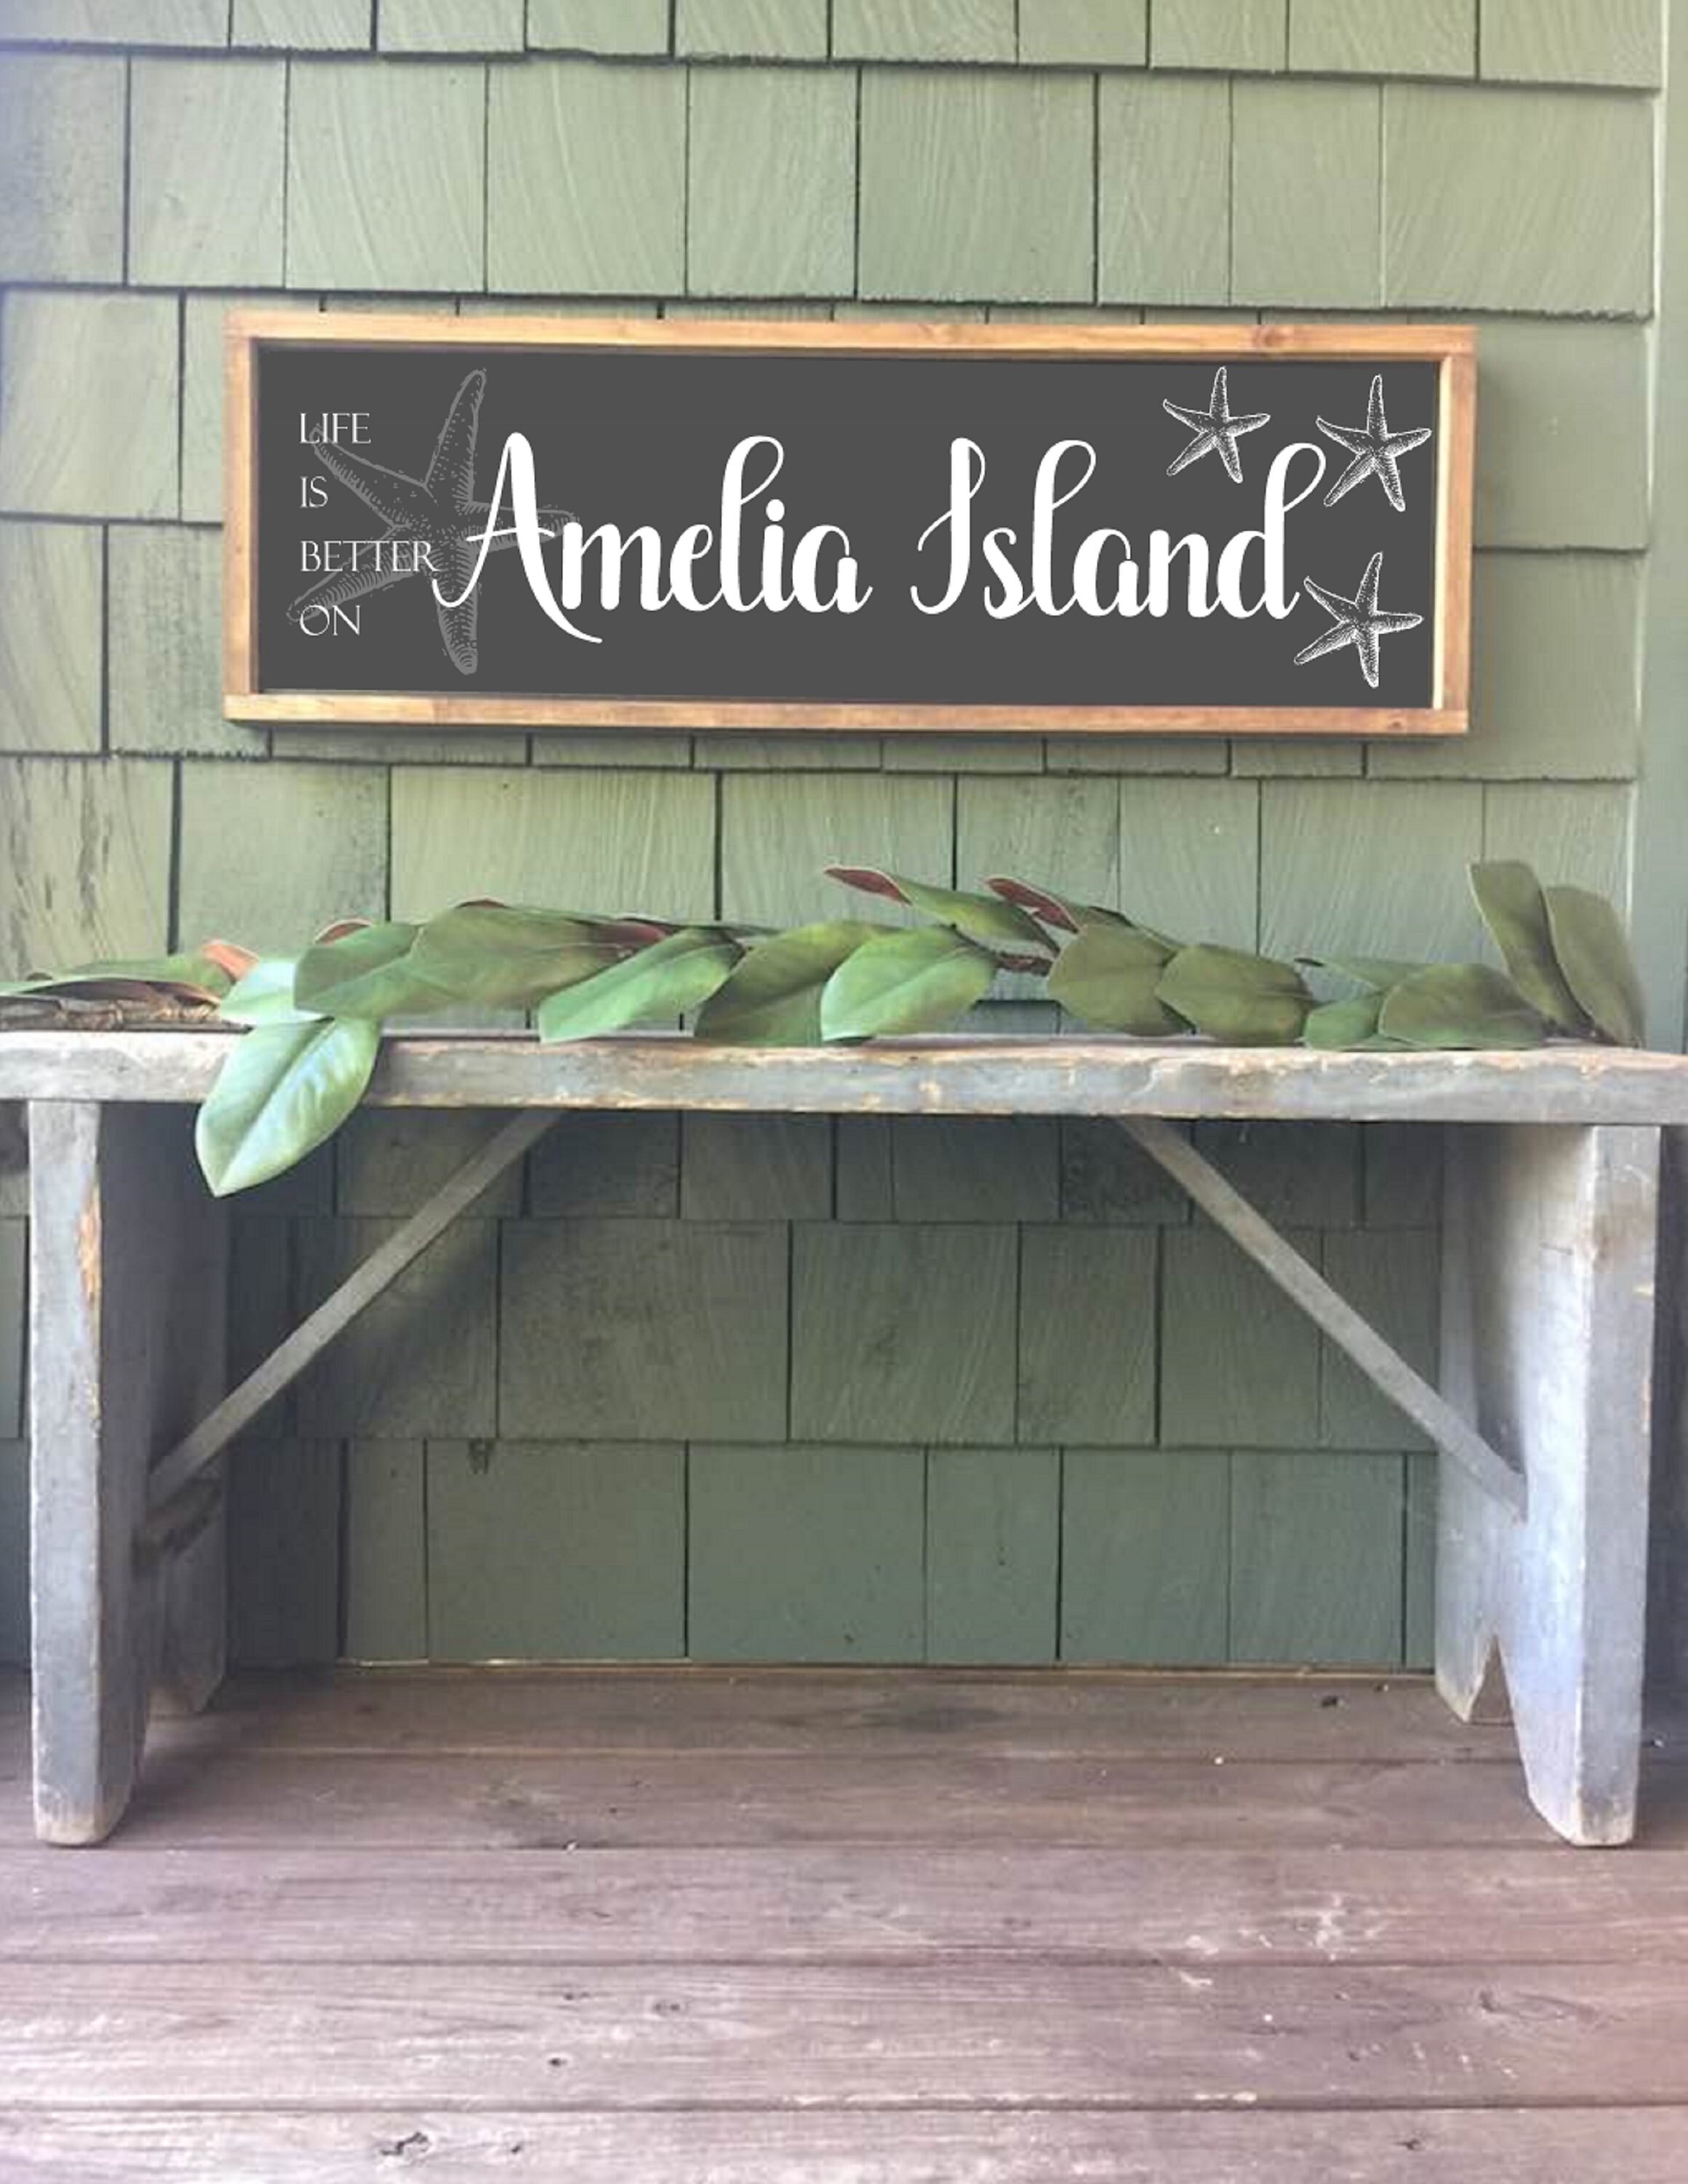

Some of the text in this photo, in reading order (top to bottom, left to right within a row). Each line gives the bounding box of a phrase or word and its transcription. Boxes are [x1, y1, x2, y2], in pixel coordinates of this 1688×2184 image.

[299, 413, 371, 443] LIFE
[299, 476, 328, 508] IS
[432, 432, 1326, 644] Amelia Island
[300, 540, 440, 572] BETTER
[298, 605, 361, 636] ON
